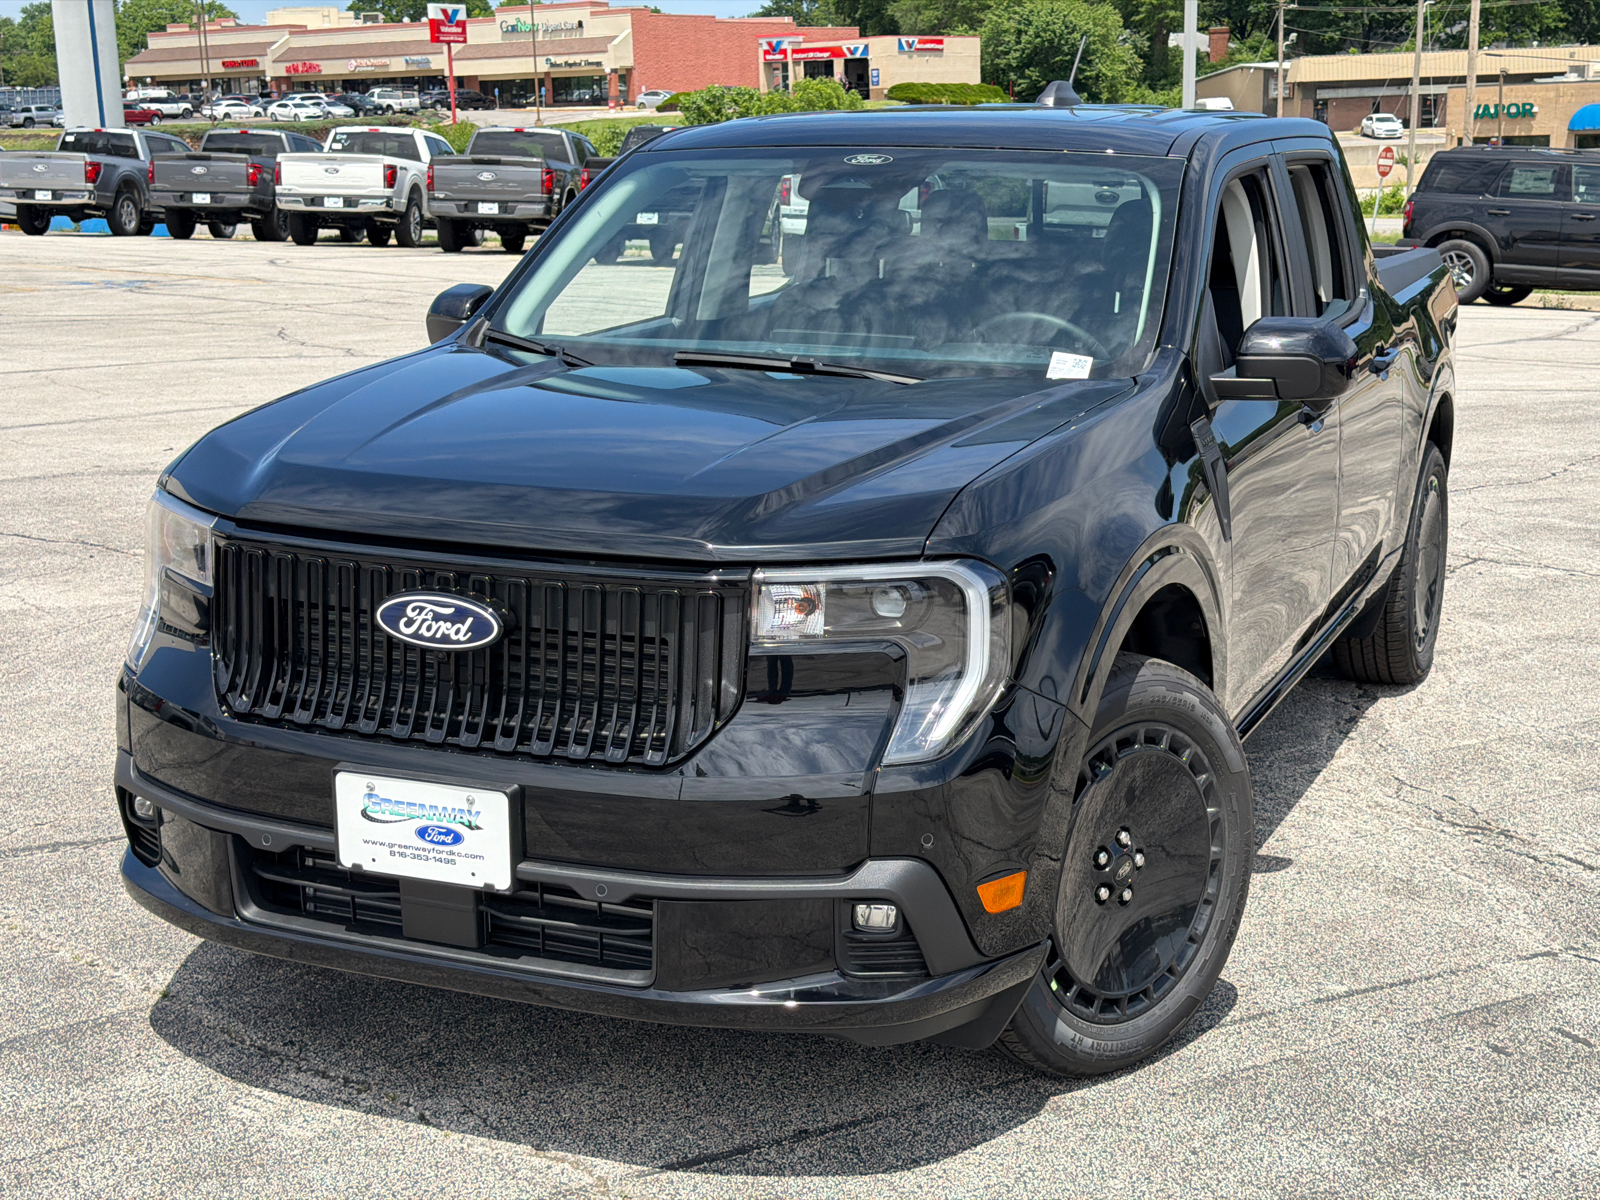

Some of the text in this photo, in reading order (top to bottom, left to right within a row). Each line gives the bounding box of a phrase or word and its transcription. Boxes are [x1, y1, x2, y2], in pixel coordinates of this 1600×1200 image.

[541, 20, 562, 32] Urgent
[563, 21, 577, 30] Care
[852, 155, 885, 163] Ford
[399, 601, 474, 642] Ford
[363, 792, 481, 827] GREENWAY
[425, 826, 454, 844] Ford
[362, 838, 485, 861] www.greenwayfordkc.com
[389, 850, 457, 866] 816-353-1495
